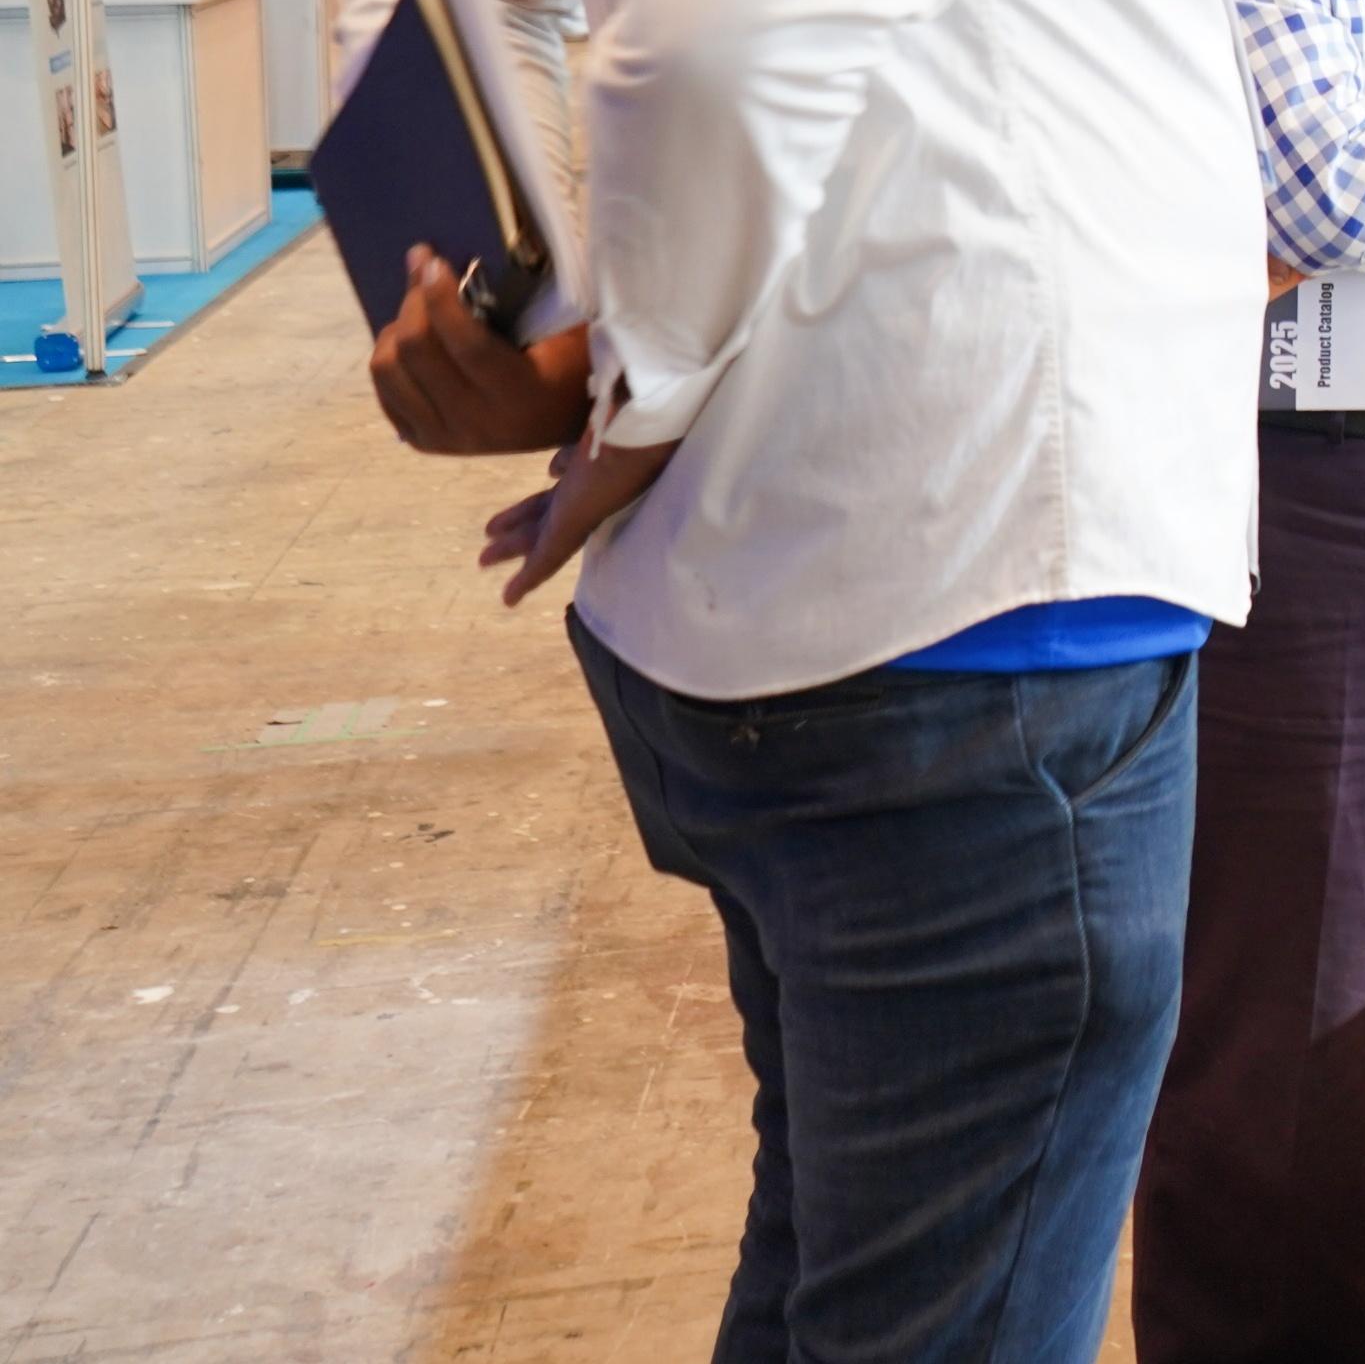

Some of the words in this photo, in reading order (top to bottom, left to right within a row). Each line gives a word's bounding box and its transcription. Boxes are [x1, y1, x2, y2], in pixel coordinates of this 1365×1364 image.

[1318, 282, 1335, 334] Catalog
[1269, 320, 1299, 390] 2025
[1317, 337, 1332, 388] Product
